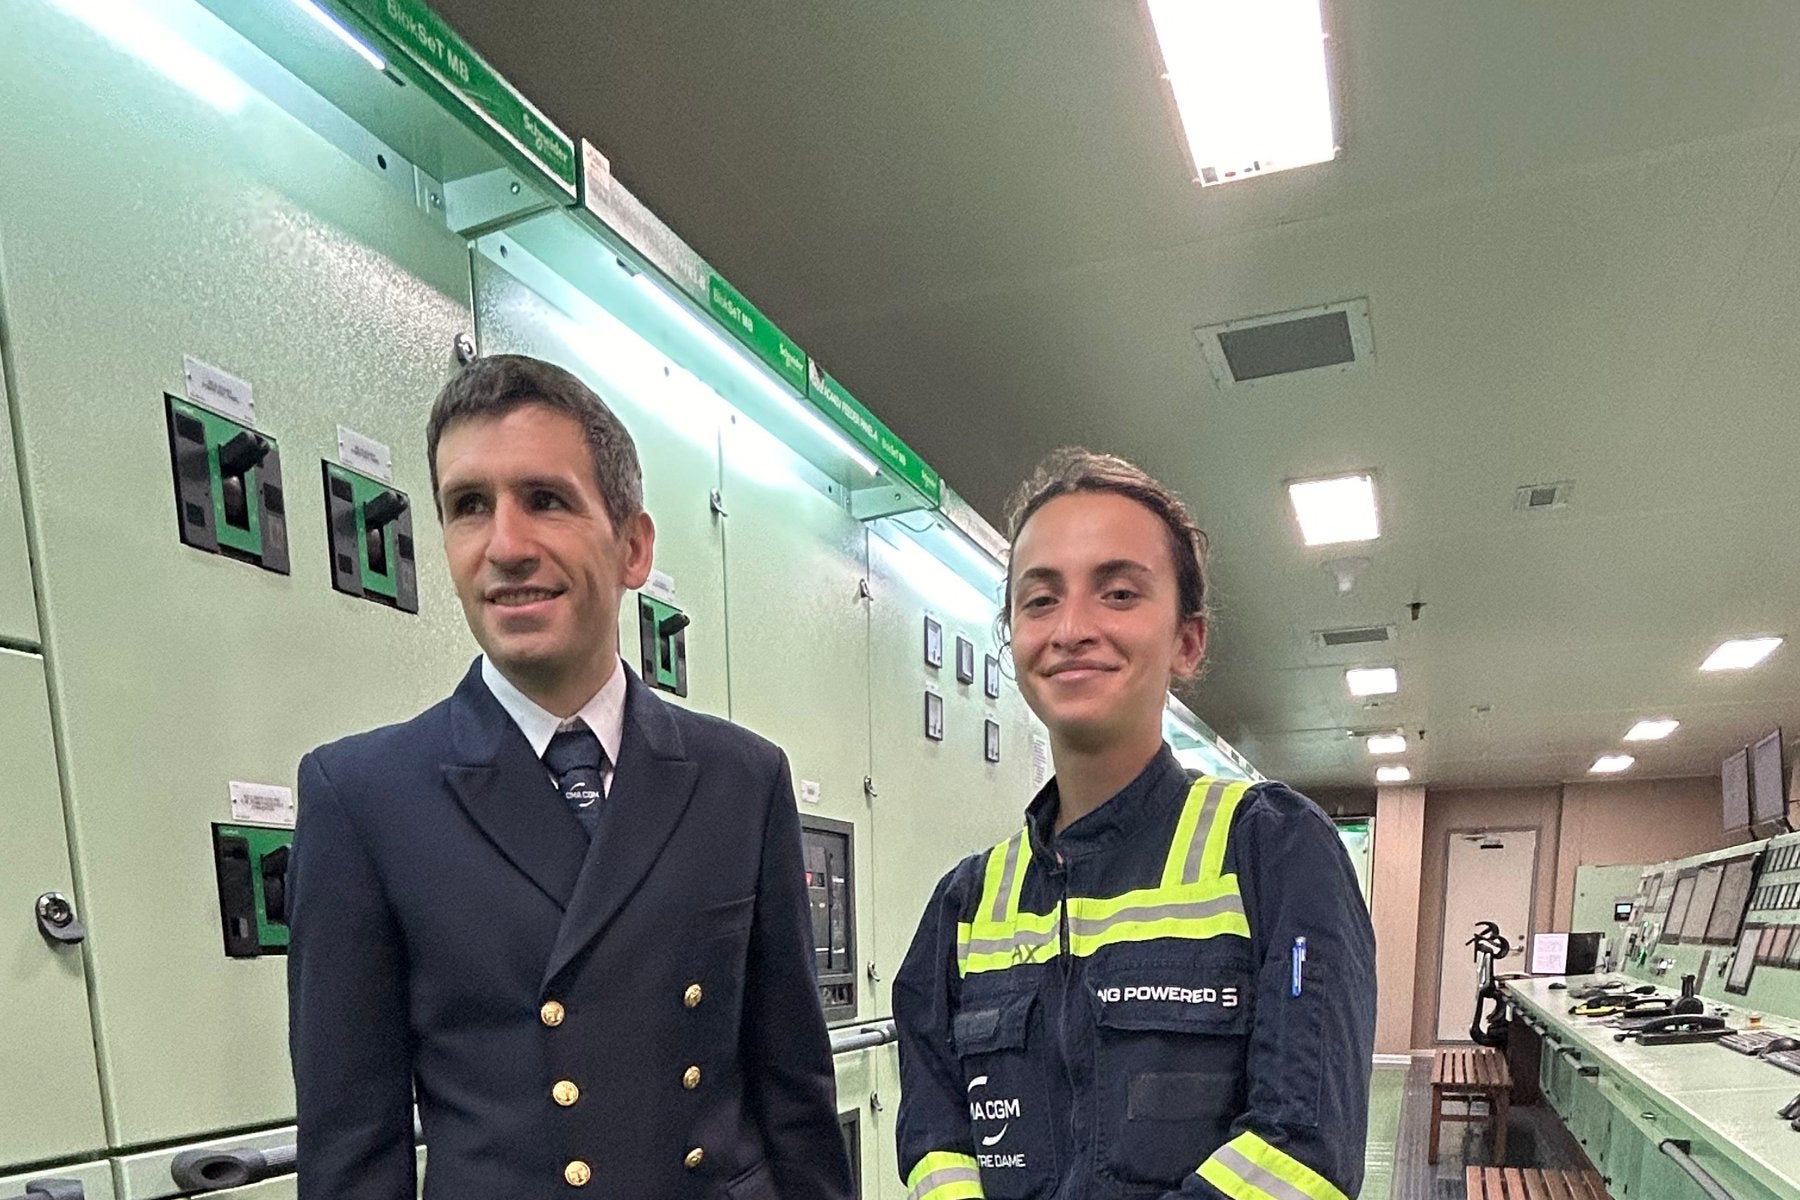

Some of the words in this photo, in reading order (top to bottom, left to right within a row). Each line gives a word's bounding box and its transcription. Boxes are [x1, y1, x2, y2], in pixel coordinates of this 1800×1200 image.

[447, 48, 469, 82] MB
[1124, 986, 1217, 1003] POWERED
[985, 1098, 1021, 1120] CGM
[994, 1153, 1026, 1168] DAME
